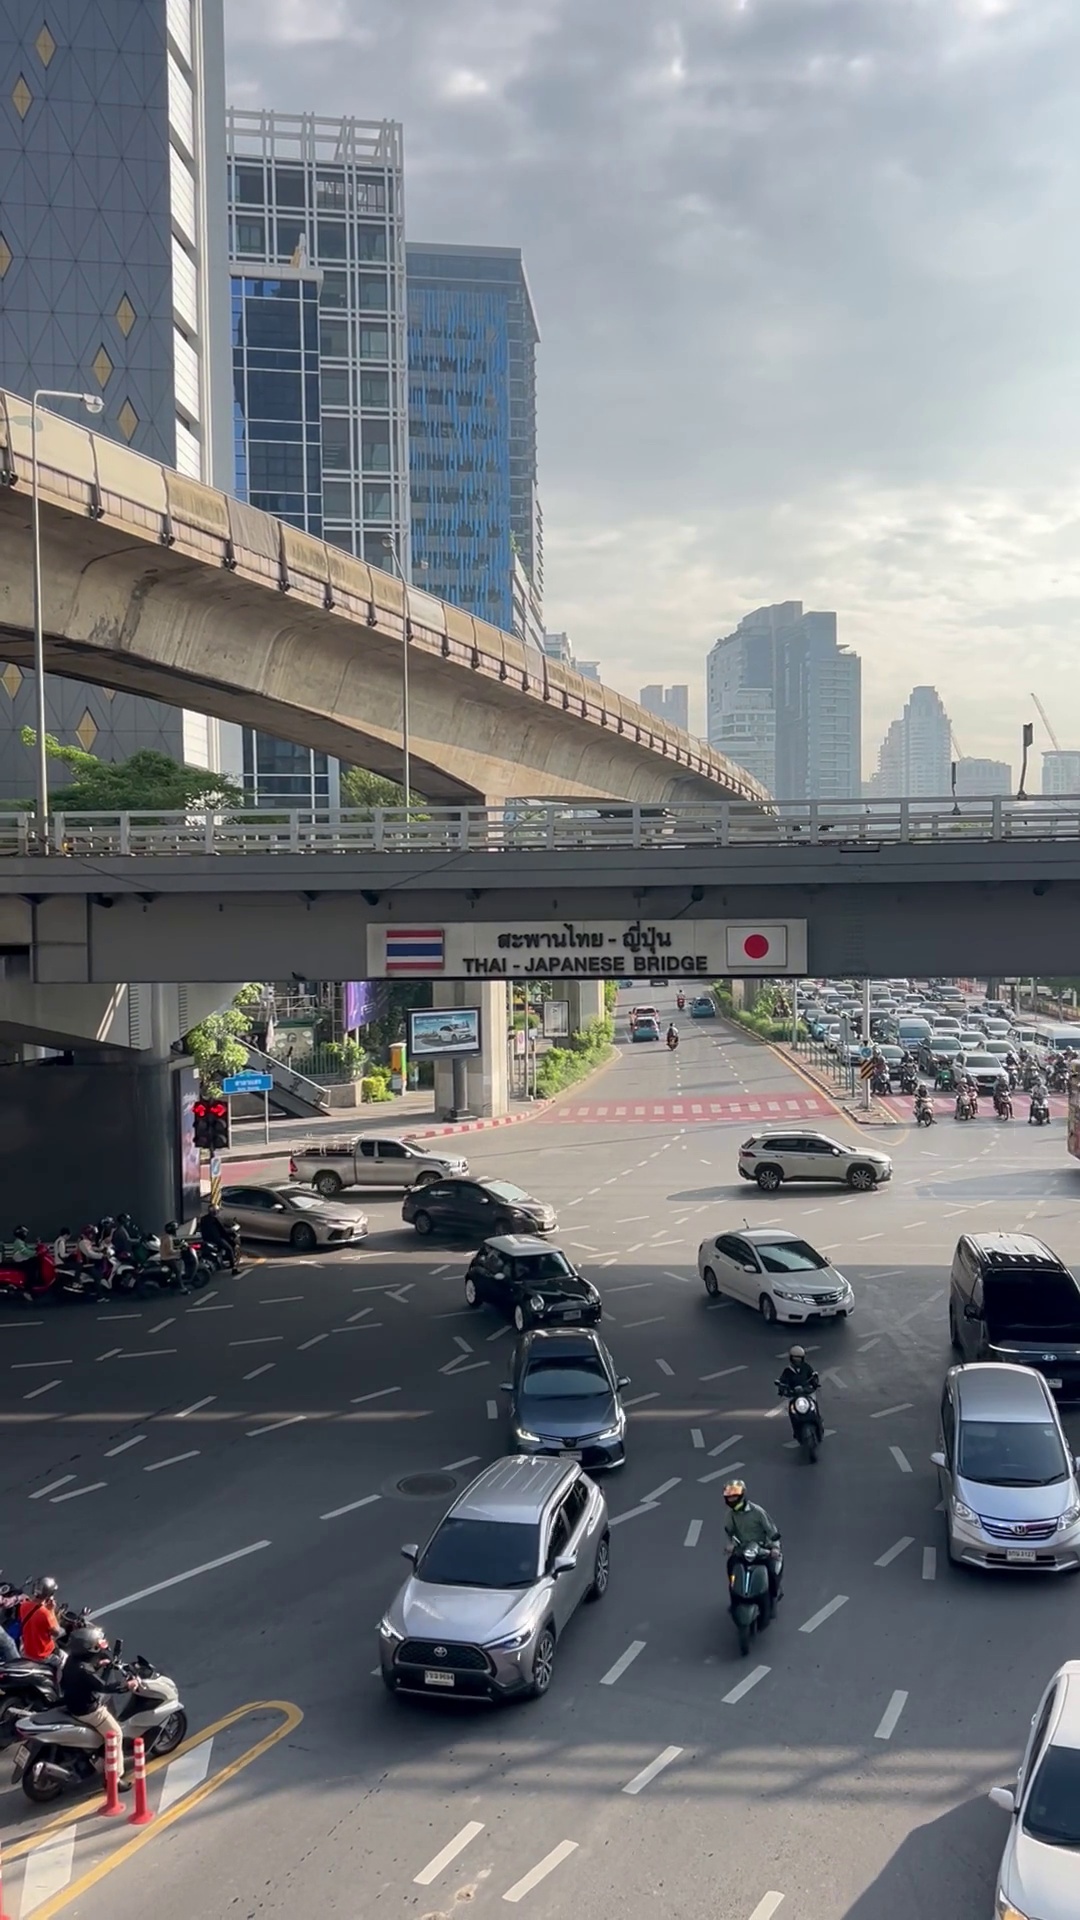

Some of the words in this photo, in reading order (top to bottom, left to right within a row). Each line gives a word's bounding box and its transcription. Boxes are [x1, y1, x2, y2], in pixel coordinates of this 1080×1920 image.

[497, 923, 604, 948] สะพานไทย
[622, 921, 670, 954] ญี่ปุ่น
[462, 957, 506, 972] THAI
[523, 956, 624, 972] JAPANESE
[632, 955, 706, 971] BRIDGE
